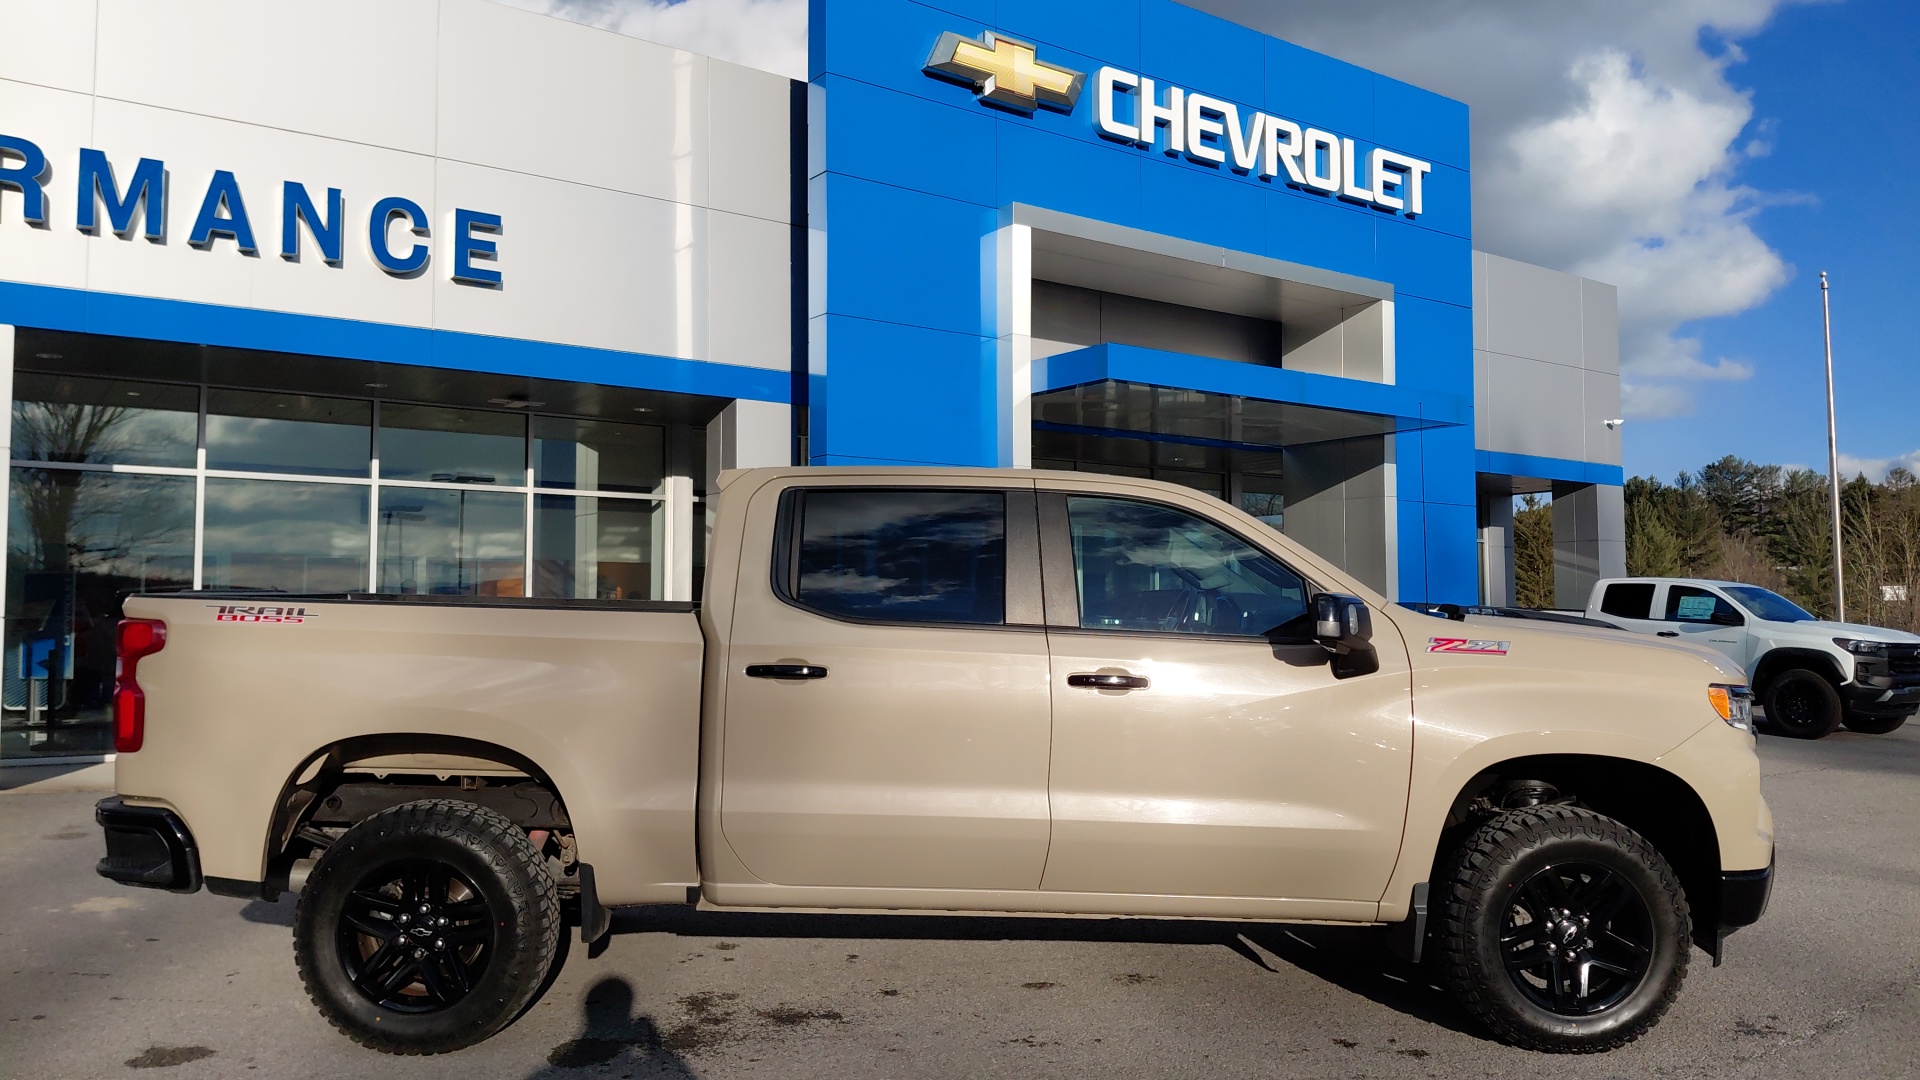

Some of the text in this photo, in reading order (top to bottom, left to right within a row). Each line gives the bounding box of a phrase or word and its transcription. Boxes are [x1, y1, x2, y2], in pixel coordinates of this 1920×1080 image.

[1094, 66, 1432, 217] CHEVROLET
[0, 134, 504, 285] RMANCE
[205, 604, 319, 617] TRAIL
[216, 614, 305, 624] BOSS
[1425, 636, 1512, 656] Z71
